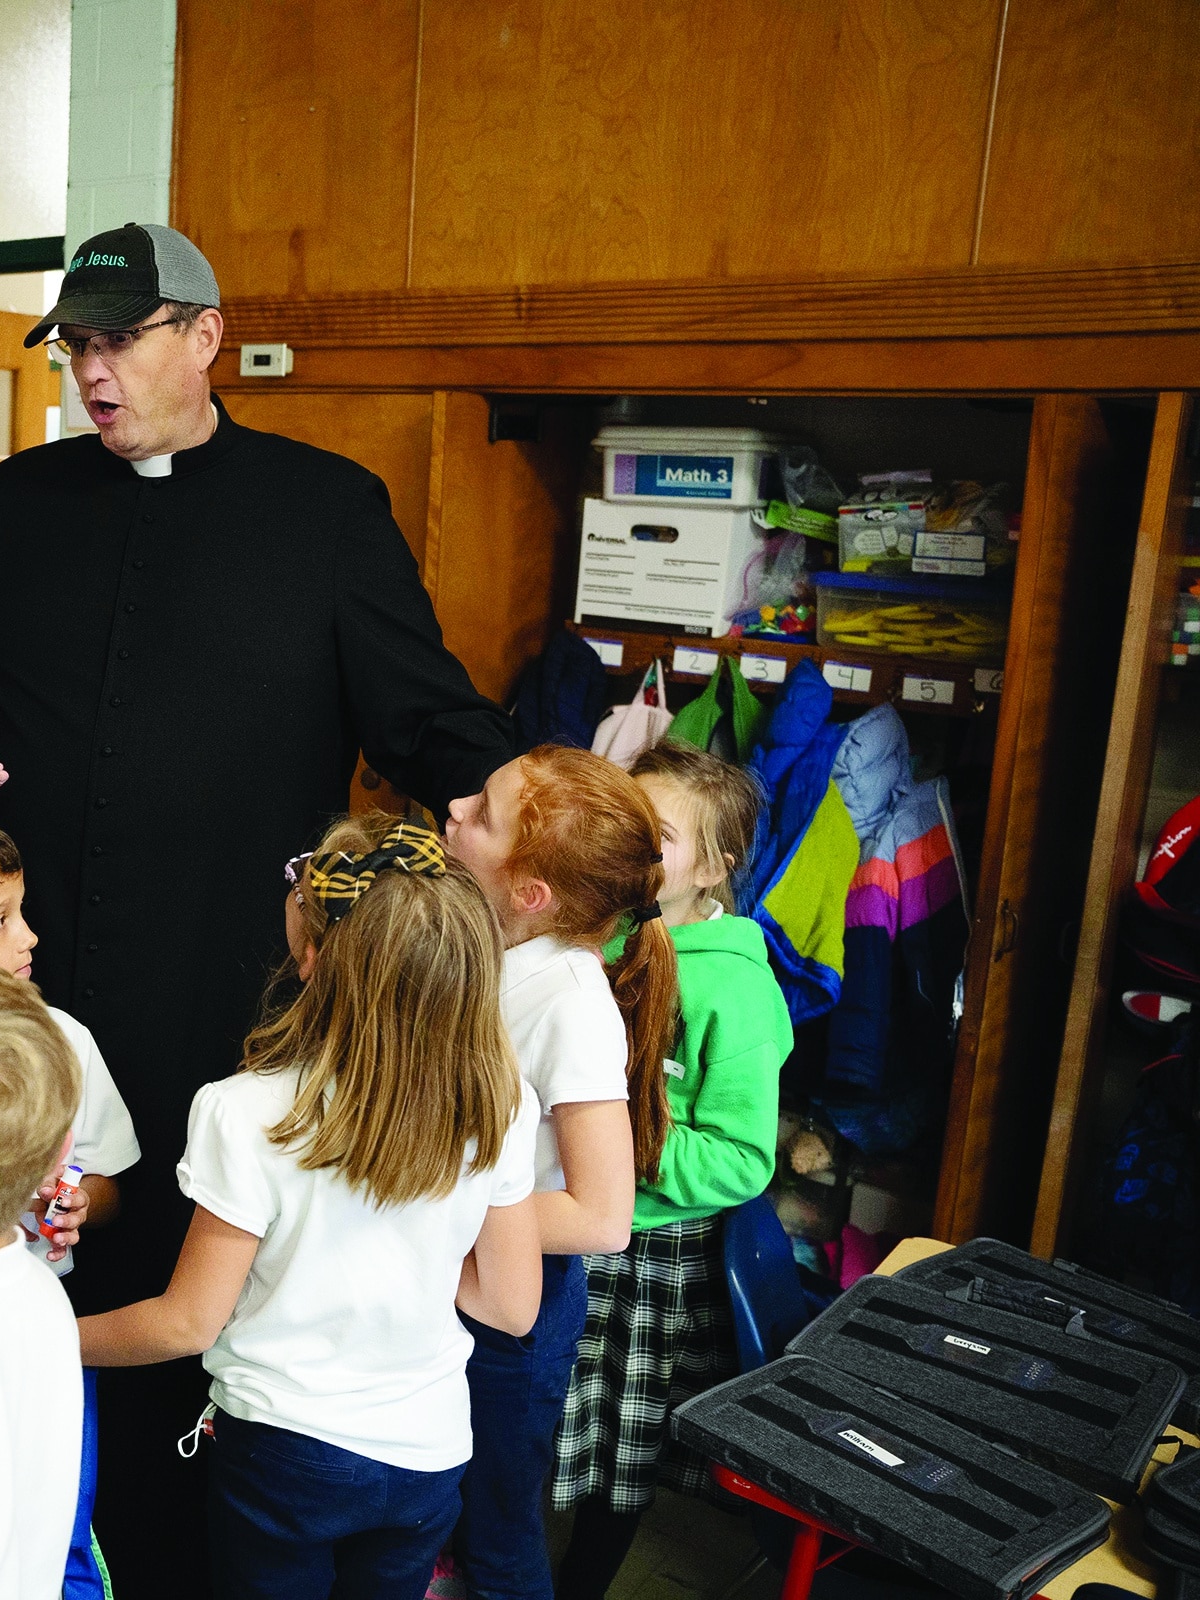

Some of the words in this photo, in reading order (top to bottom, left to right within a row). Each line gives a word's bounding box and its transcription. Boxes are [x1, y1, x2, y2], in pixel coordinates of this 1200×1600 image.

[85, 250, 129, 268] Jesus.
[665, 467, 712, 483] Math
[716, 468, 729, 484] 3
[688, 653, 700, 671] 2
[754, 659, 769, 680] 3
[837, 668, 855, 691] 4
[920, 681, 937, 701] 5
